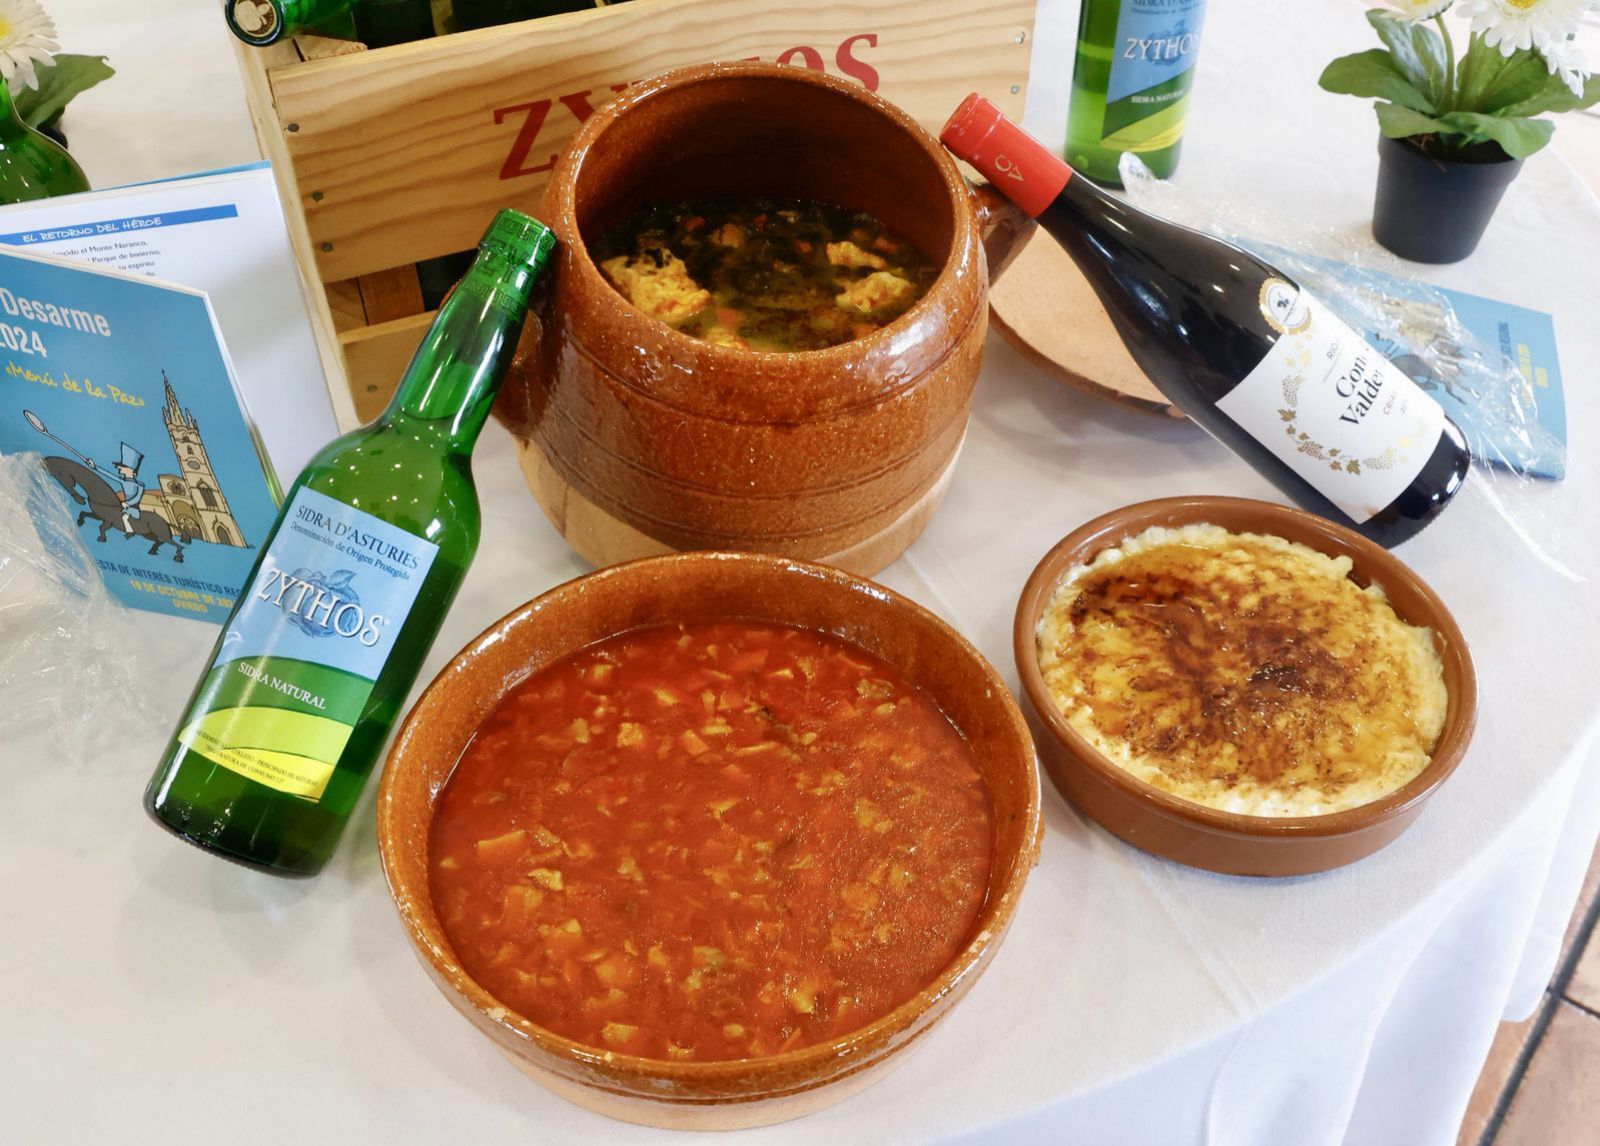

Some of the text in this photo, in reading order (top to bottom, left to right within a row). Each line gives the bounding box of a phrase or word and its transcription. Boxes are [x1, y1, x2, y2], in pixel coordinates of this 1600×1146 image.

[22, 217, 162, 243] EL RETORNO DEL HÉROE
[80, 246, 88, 254] el
[89, 243, 112, 253] Monte
[114, 240, 148, 250] Naranco,
[92, 254, 117, 264] Parque
[119, 252, 128, 260] de
[0, 287, 112, 337] Desarme
[62, 372, 82, 392] de
[84, 378, 107, 398] la
[290, 521, 410, 581] Denominación de Origen Protegida
[296, 505, 421, 569] SIDRA D'ASTURIES
[120, 564, 131, 575] DE
[132, 567, 173, 584] INTERÉS
[173, 575, 223, 594] TURÍSTICO
[257, 567, 385, 648] ZYTHOS
[238, 661, 327, 711] SIDRA NATURAL
